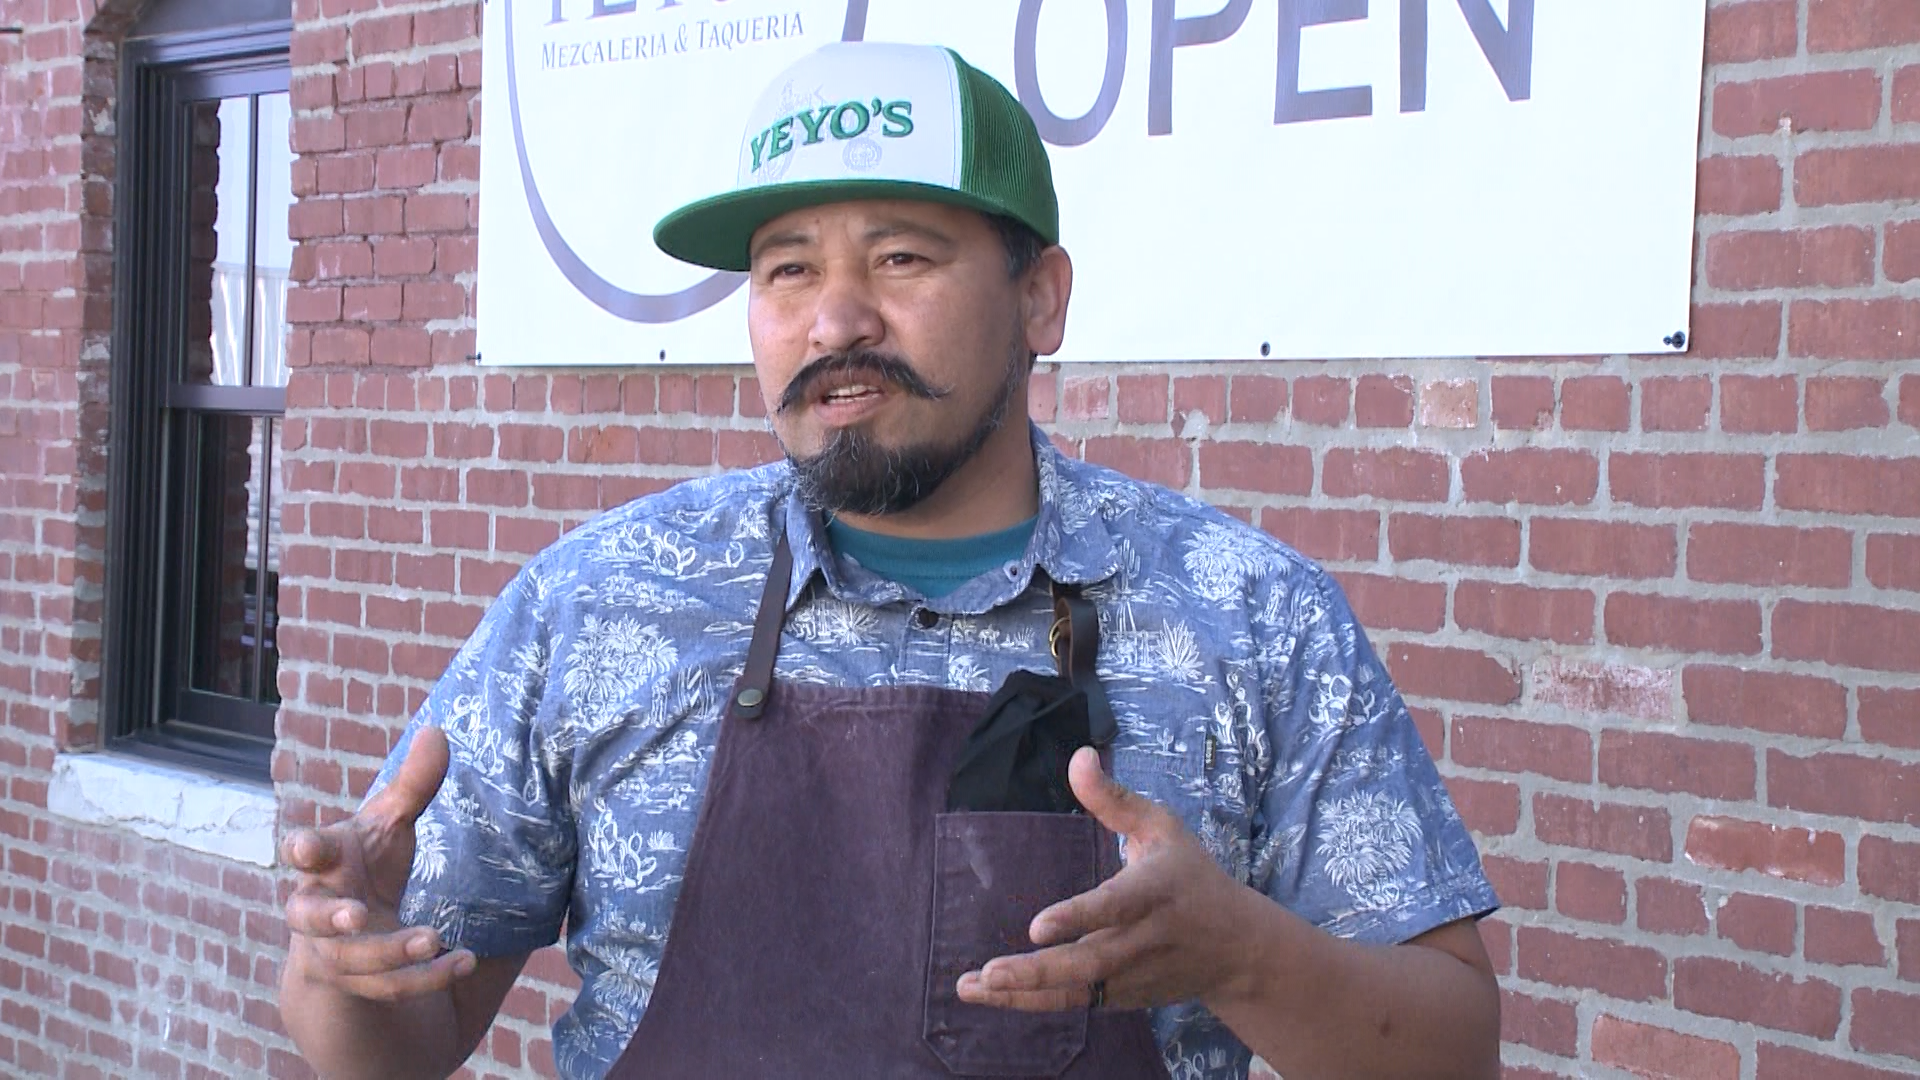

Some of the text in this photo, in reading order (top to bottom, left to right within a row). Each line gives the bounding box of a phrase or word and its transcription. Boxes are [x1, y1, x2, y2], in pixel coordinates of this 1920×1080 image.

[674, 23, 688, 53] &
[1013, 0, 1532, 147] OPEN
[750, 97, 914, 173] YEYO'S
